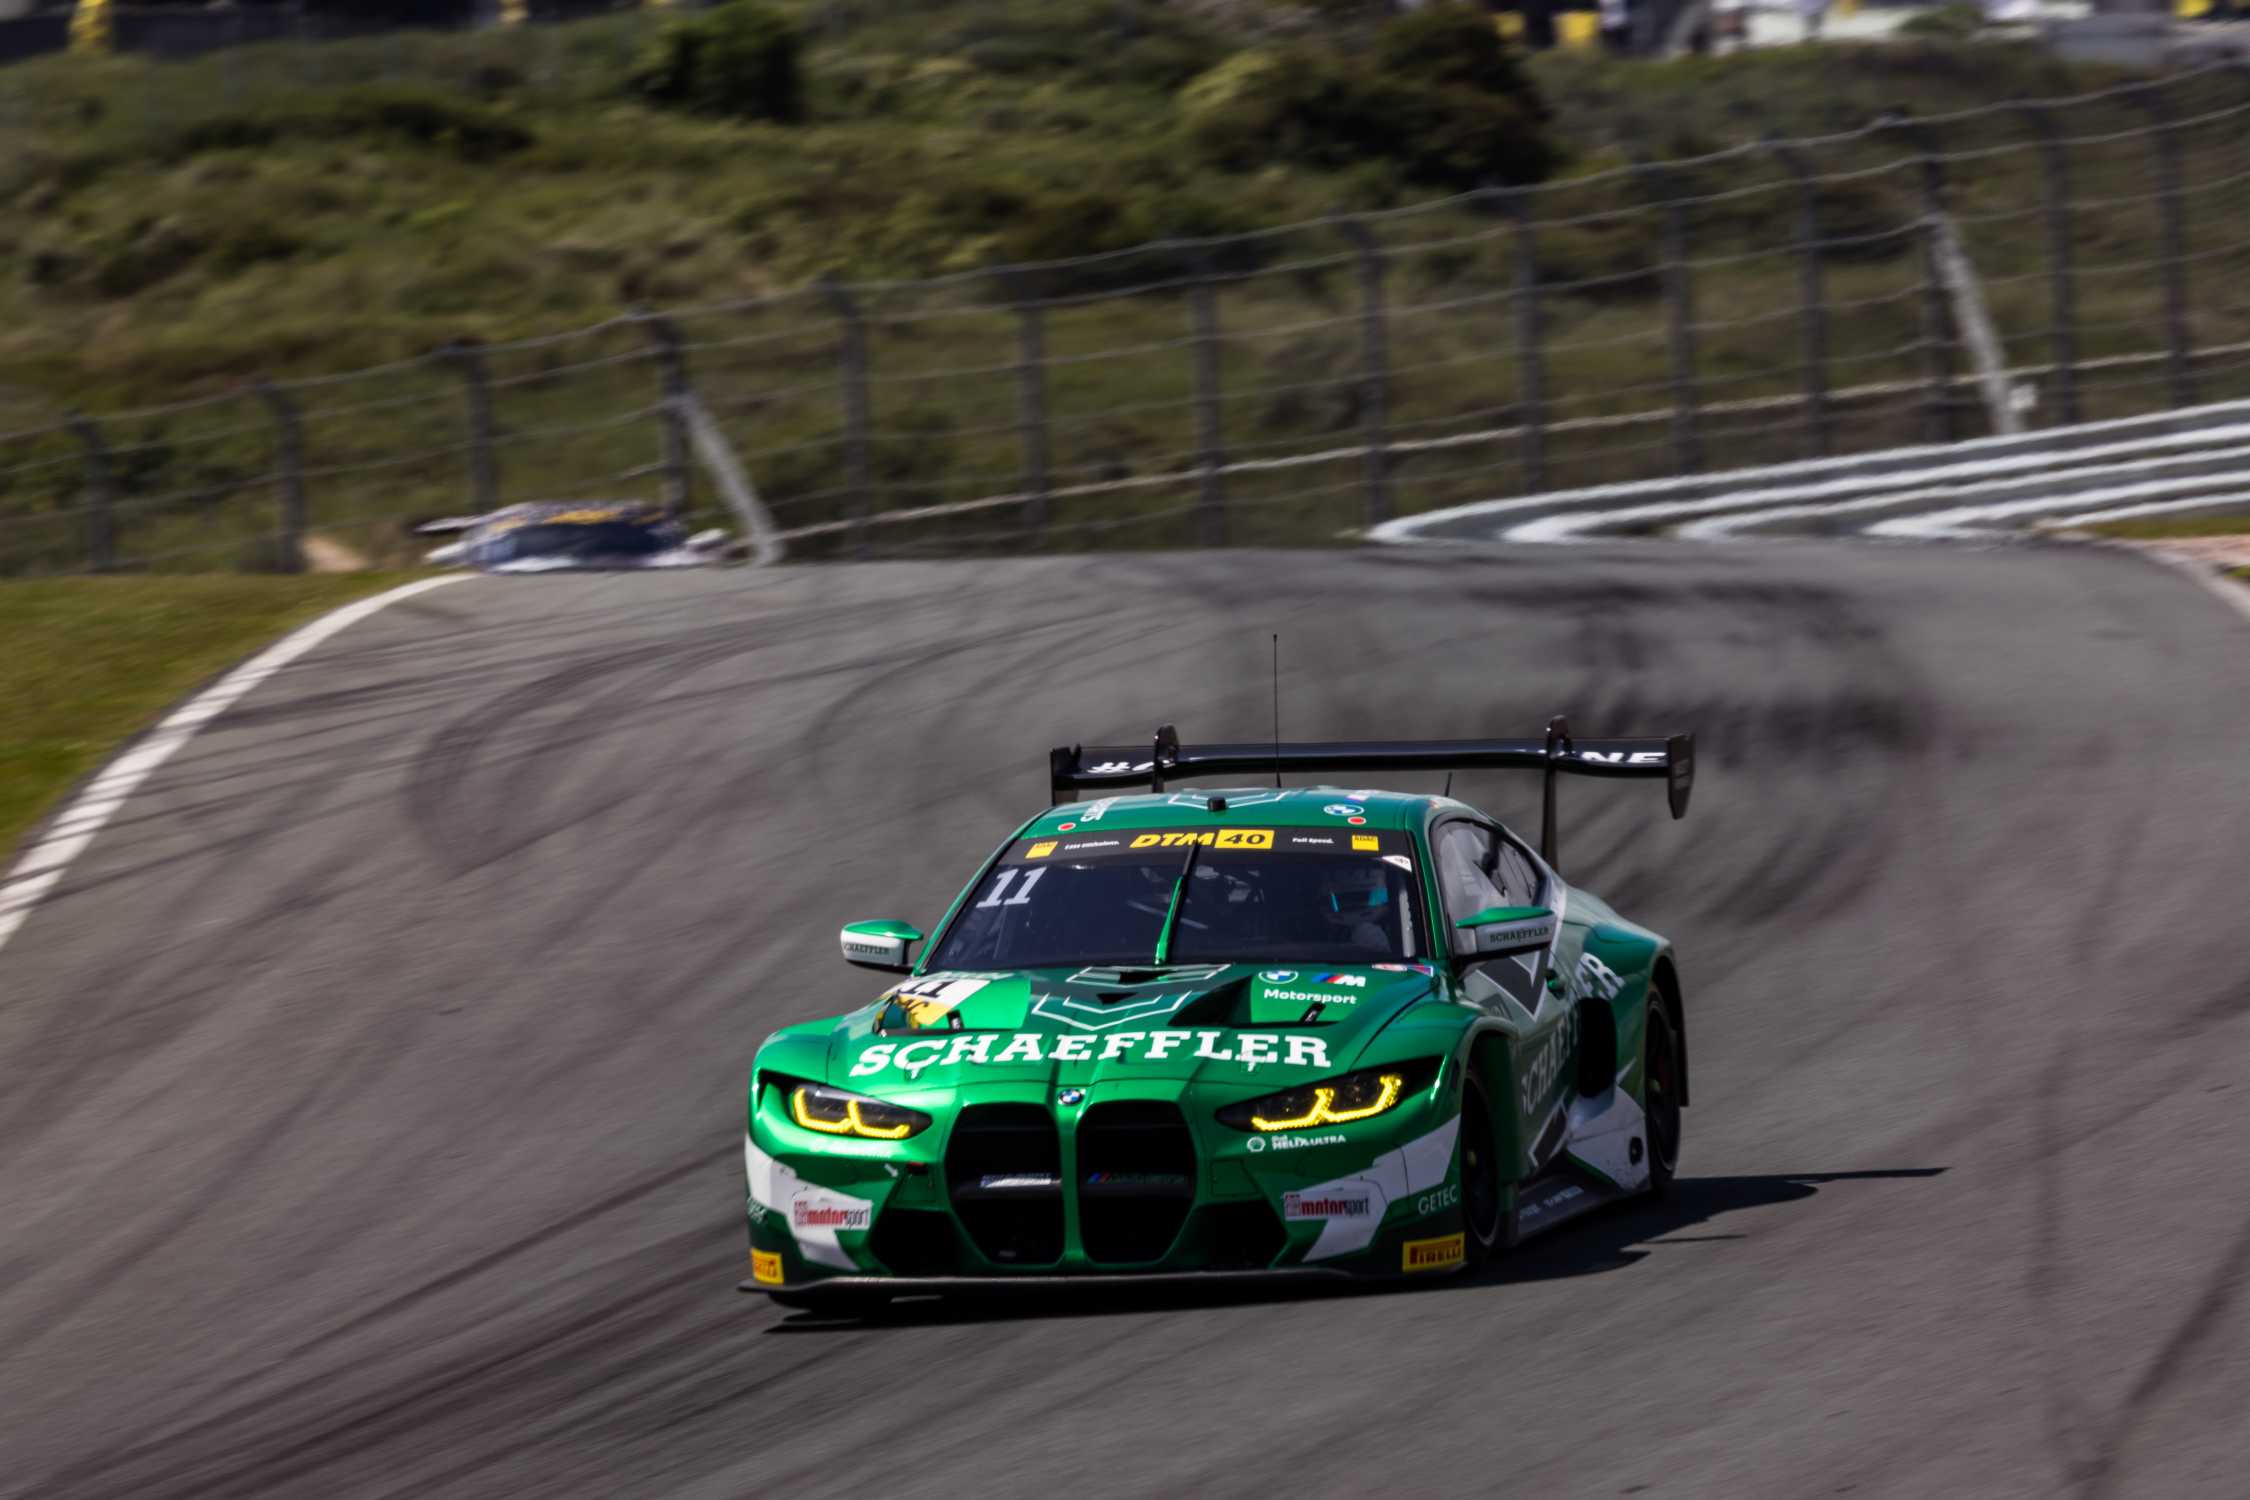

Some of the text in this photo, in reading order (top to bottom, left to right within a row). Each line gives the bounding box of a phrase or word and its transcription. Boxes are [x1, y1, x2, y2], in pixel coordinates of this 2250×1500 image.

[1129, 833, 1214, 848] DTM
[1223, 833, 1266, 845] 40
[976, 866, 1047, 908] 11
[898, 979, 958, 998] 11
[1263, 988, 1357, 1004] Motorsport
[849, 1031, 1332, 1077] SCHAEFFLER
[1417, 1184, 1458, 1215] GETEC
